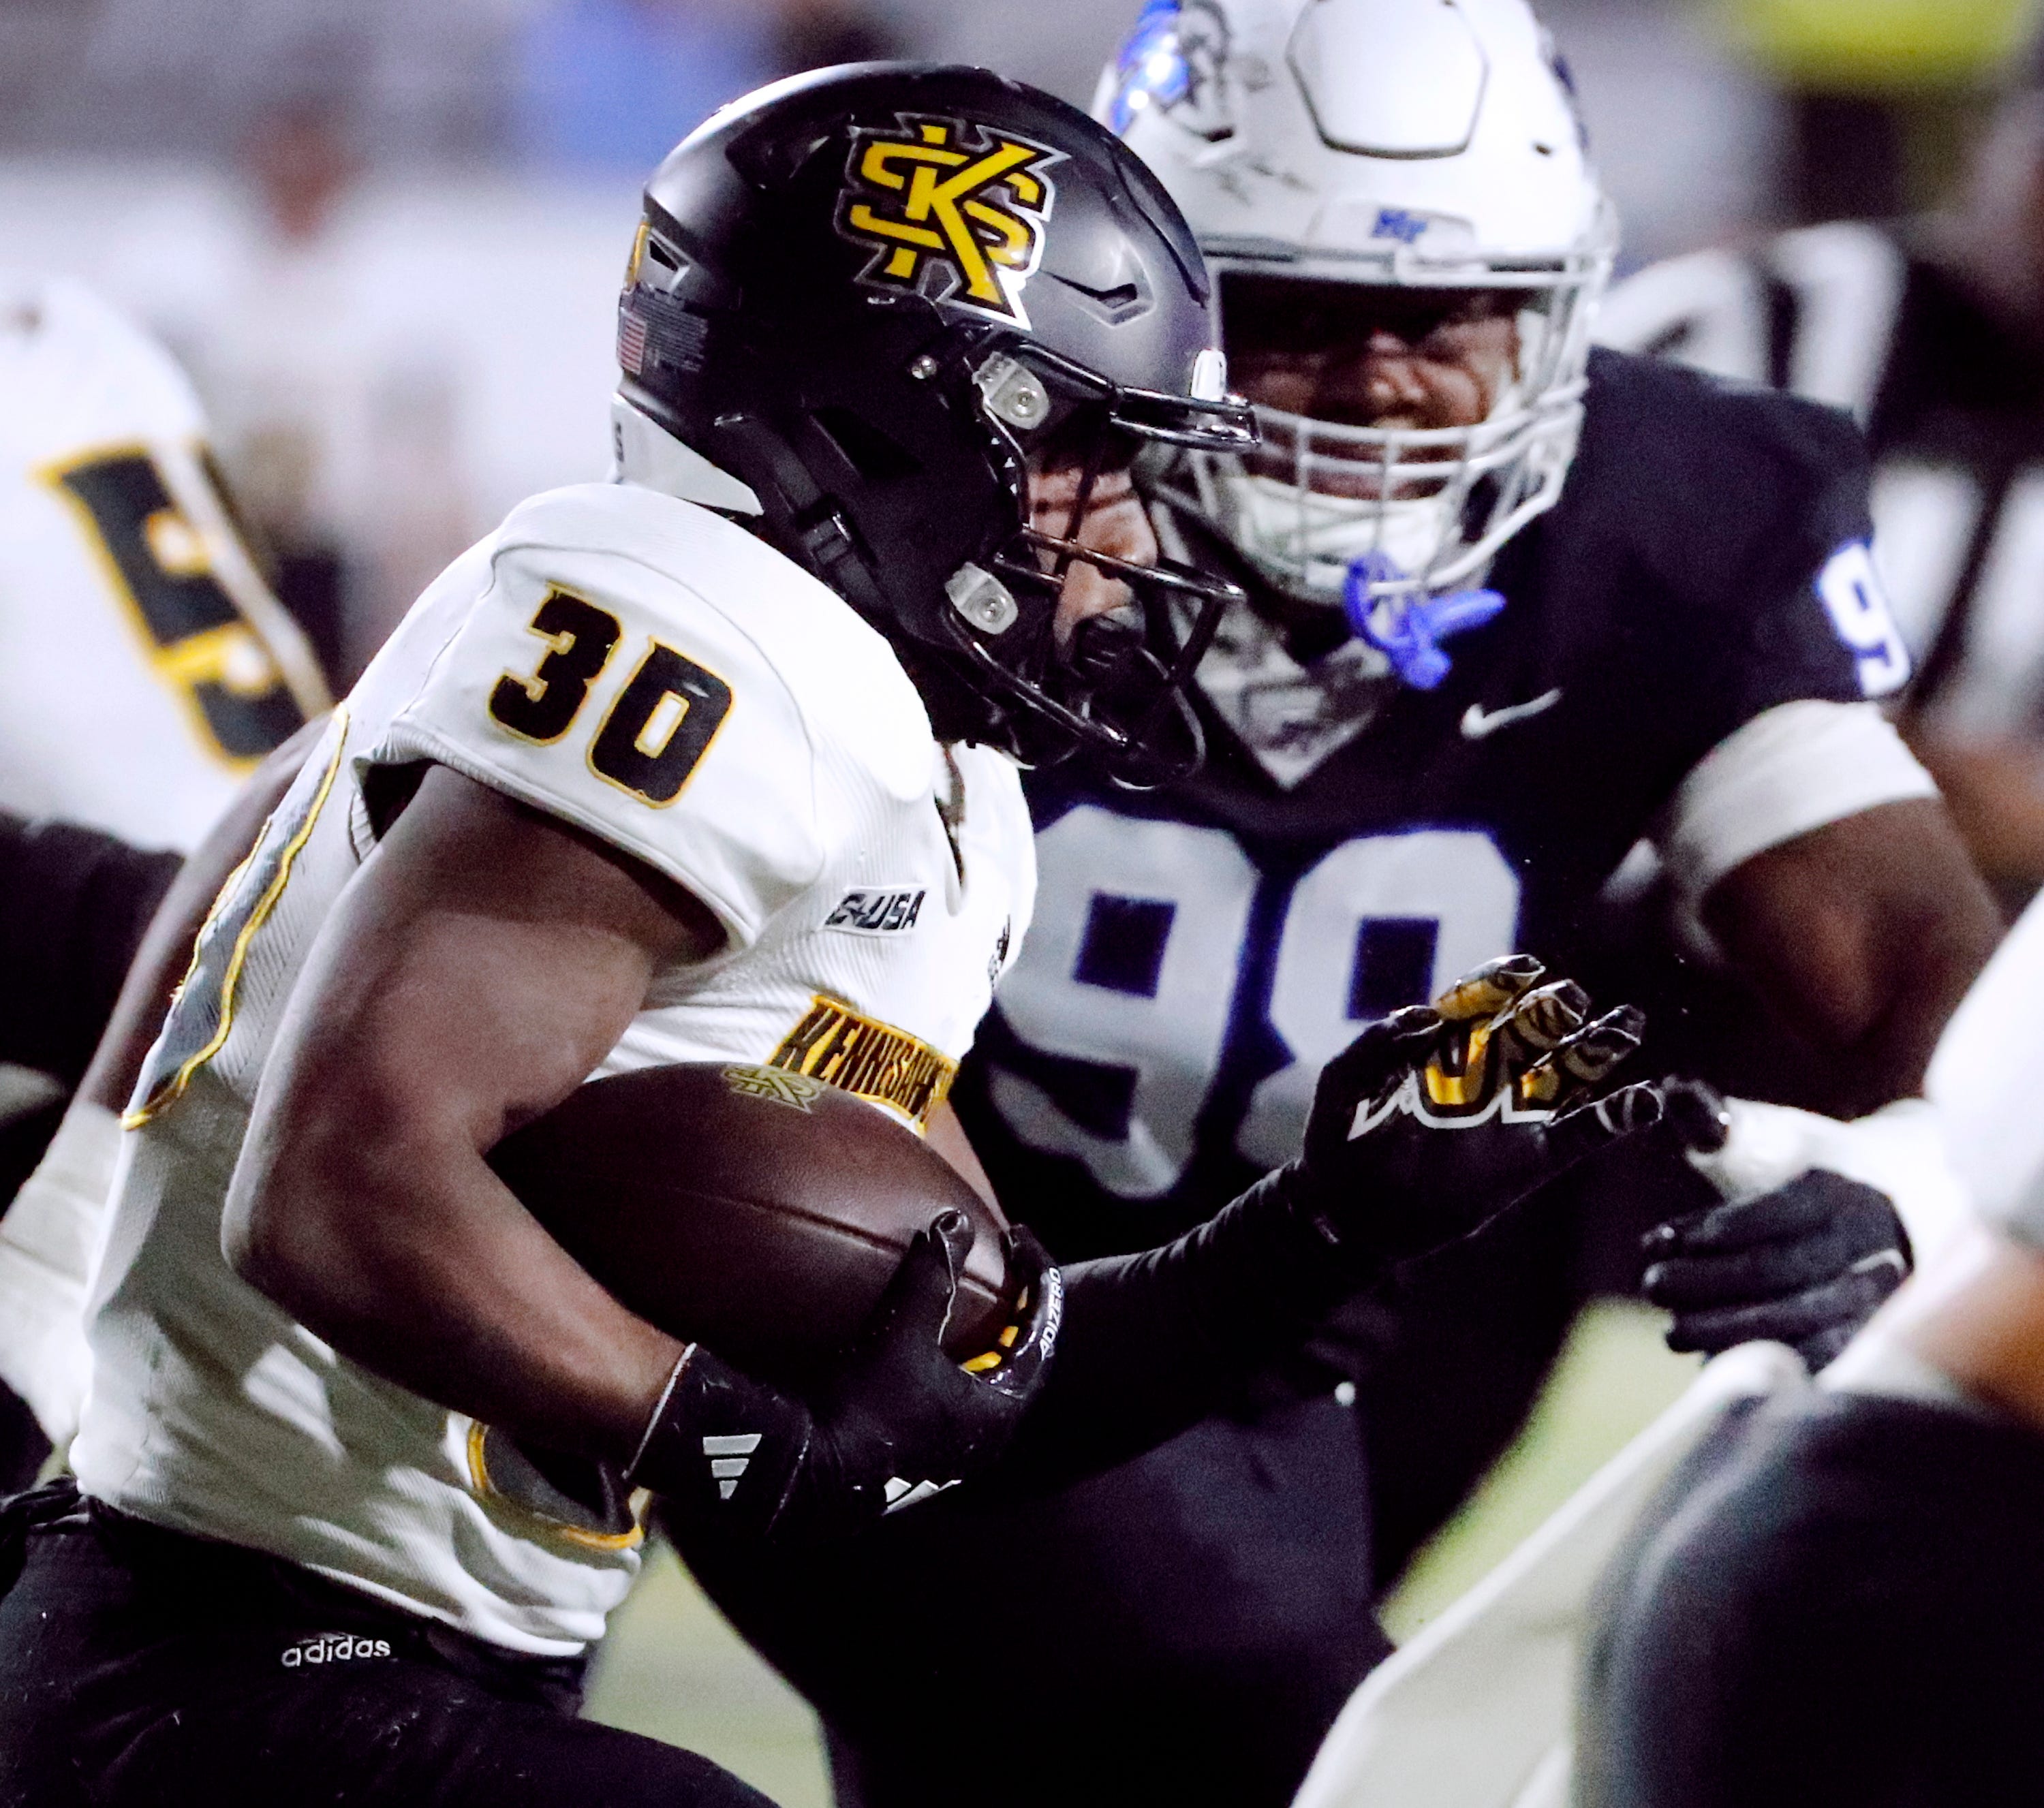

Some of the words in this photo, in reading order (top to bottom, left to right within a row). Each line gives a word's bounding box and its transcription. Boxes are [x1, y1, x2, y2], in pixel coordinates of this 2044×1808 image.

[487, 581, 734, 810] 30
[1040, 1267, 1063, 1361] ADIZERO
[281, 1634, 392, 1668] adidas
